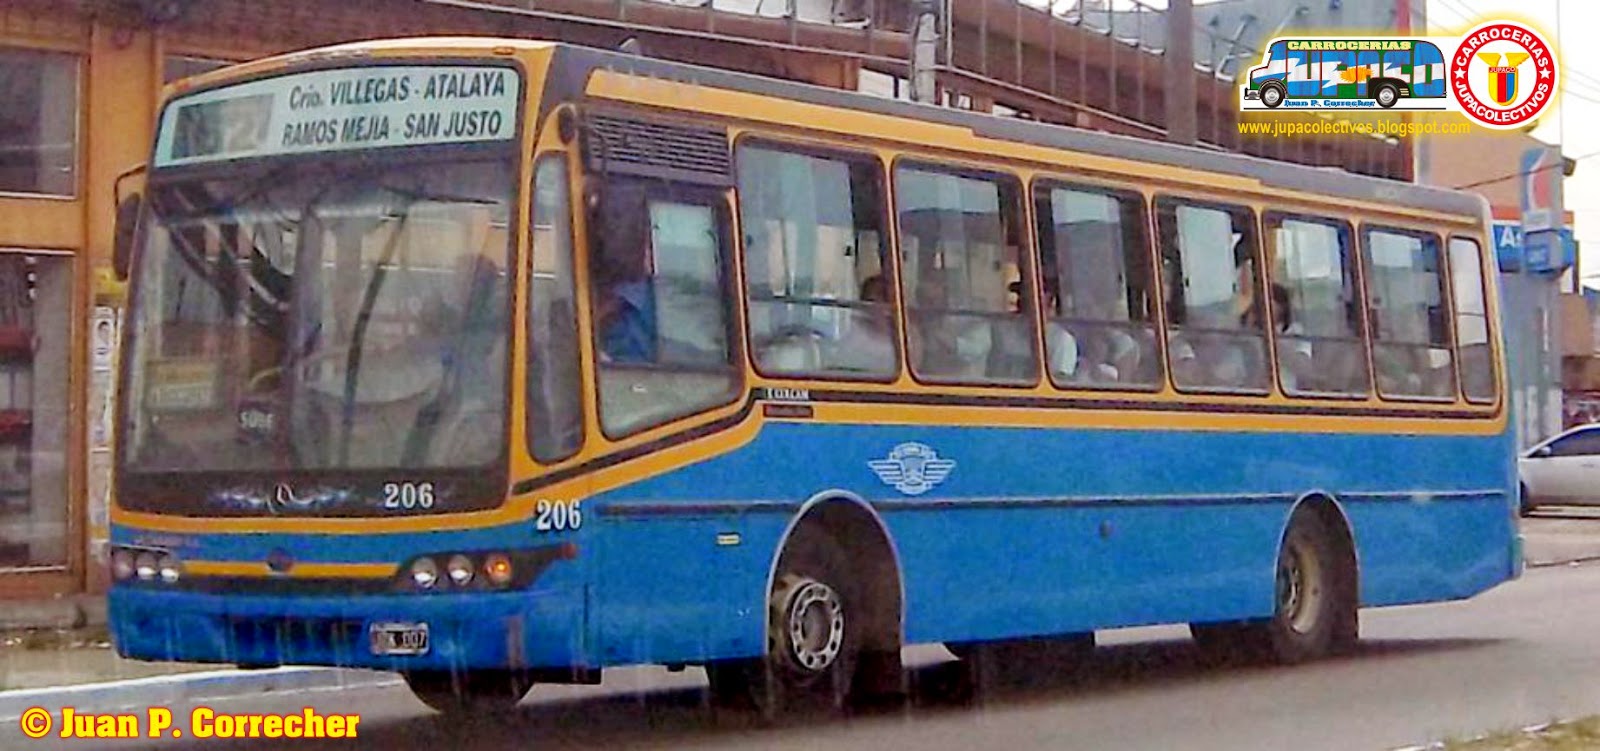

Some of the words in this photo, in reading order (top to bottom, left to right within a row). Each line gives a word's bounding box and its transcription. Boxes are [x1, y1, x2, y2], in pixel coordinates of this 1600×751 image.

[331, 76, 409, 105] VILLEGAS
[424, 71, 504, 100] ATALAYA
[283, 119, 338, 145] RAMOS
[341, 116, 389, 142] MEJIA
[403, 112, 440, 138] SAN
[443, 110, 502, 137] JUSTO
[384, 482, 435, 509] 206
[535, 499, 582, 532] 206
